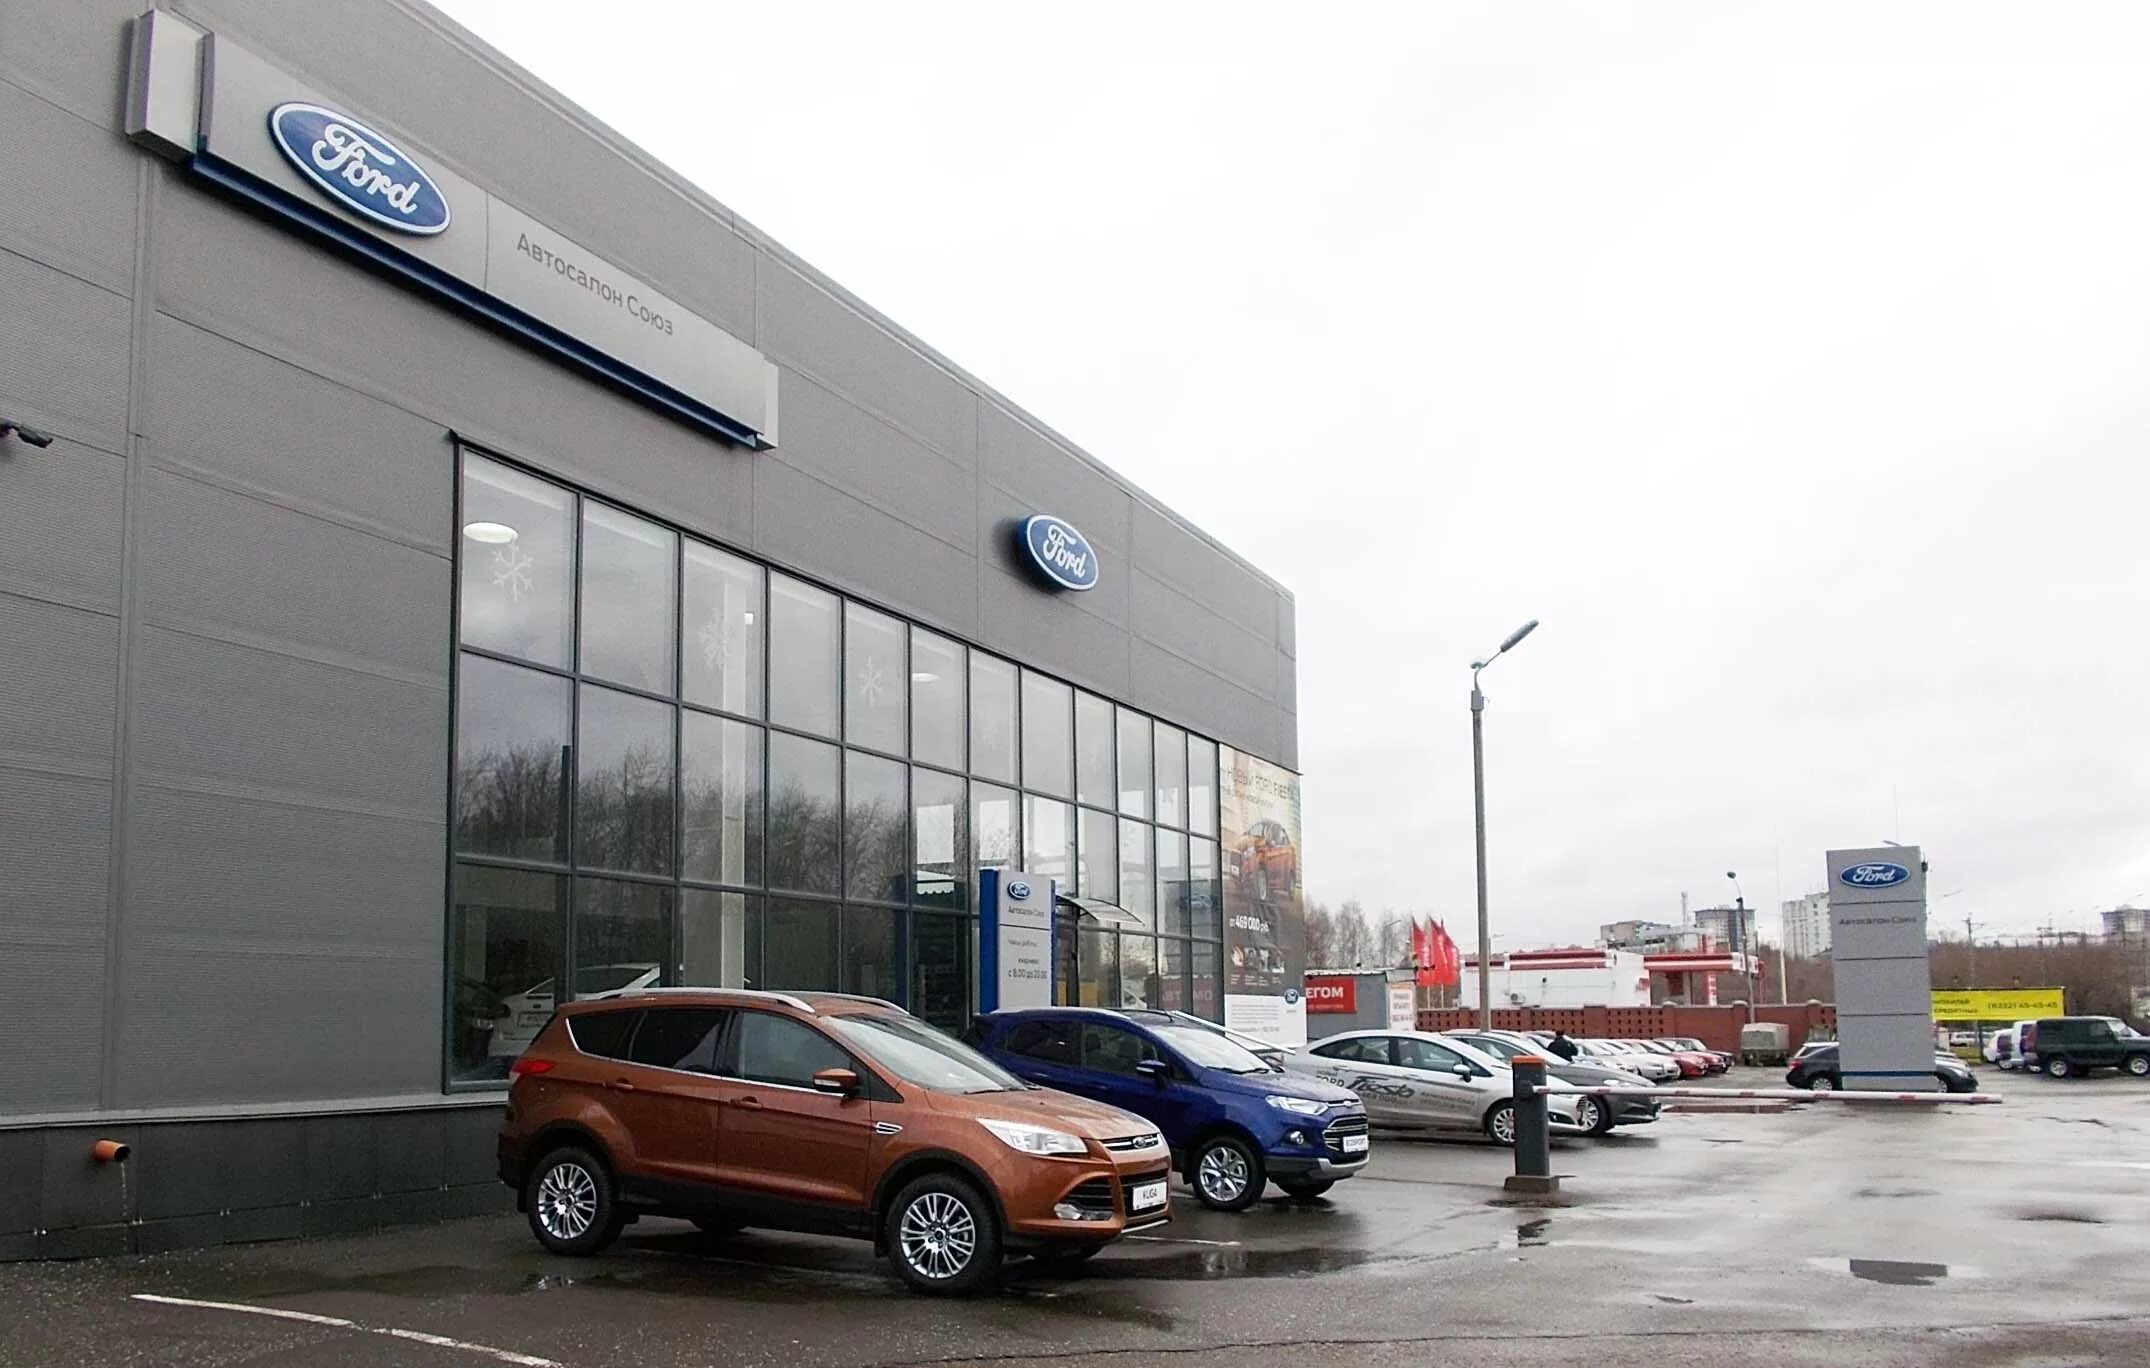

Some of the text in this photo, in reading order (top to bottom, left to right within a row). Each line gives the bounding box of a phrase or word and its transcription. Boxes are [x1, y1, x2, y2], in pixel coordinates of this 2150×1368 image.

[311, 123, 417, 214] Ford
[516, 232, 674, 336] Автосалон Союз
[1043, 524, 1086, 578] Ford
[1852, 866, 1896, 882] Ford
